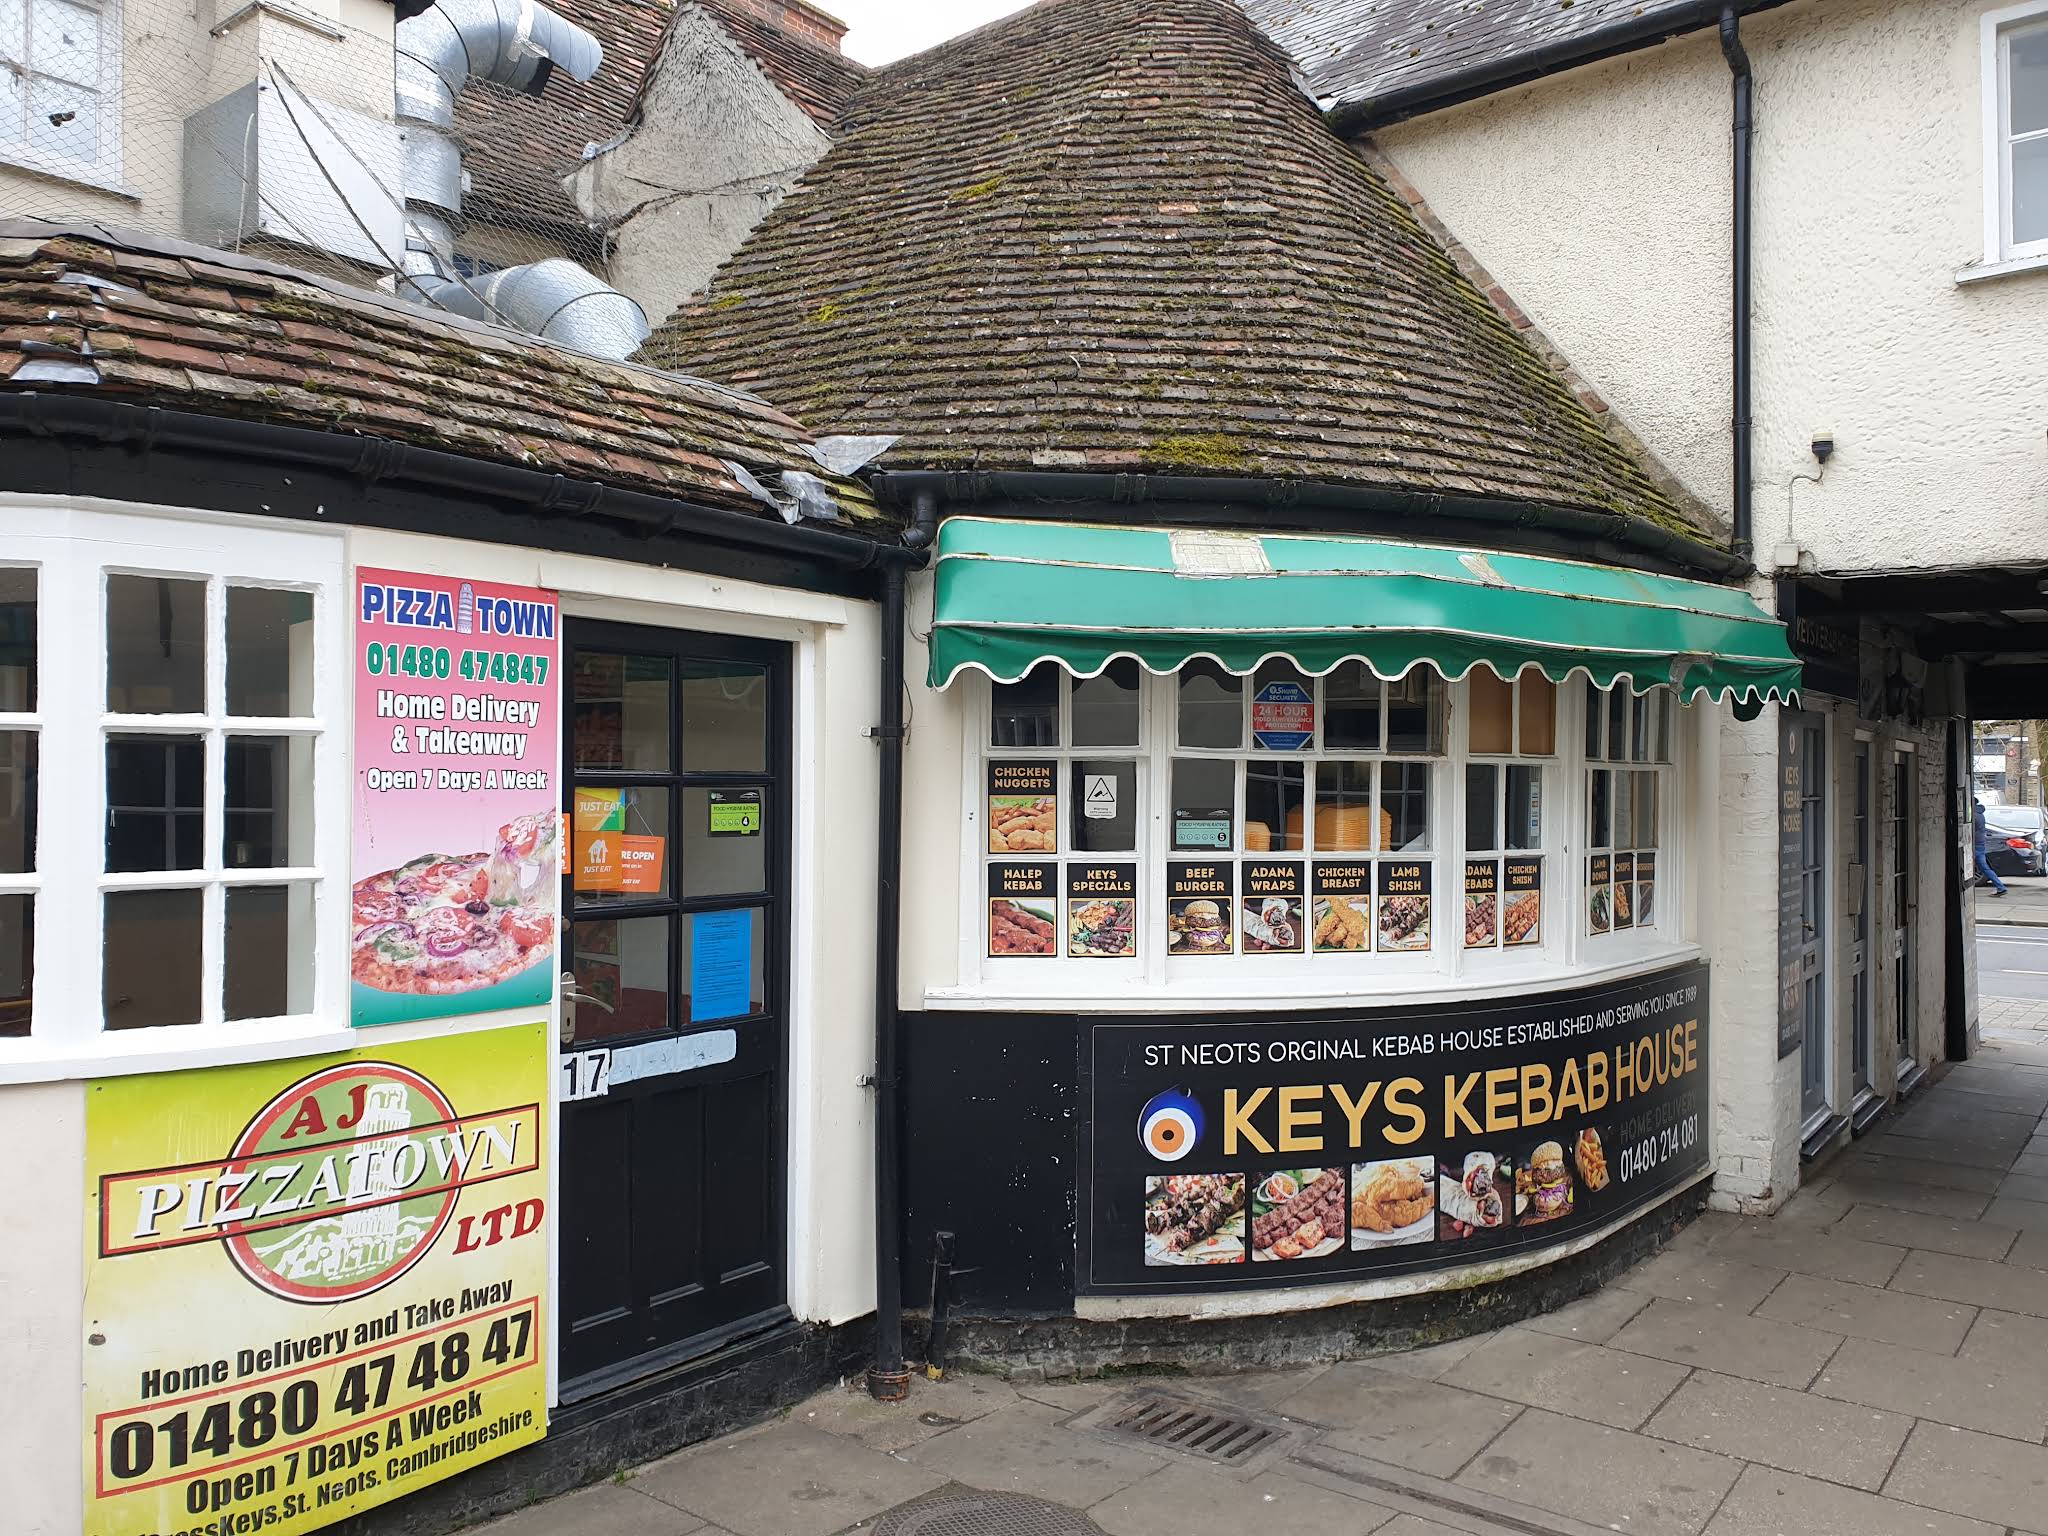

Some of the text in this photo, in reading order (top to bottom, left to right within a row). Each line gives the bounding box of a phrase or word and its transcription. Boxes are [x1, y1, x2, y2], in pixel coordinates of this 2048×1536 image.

[362, 583, 555, 640] PIZZA TOWN
[367, 641, 549, 687] 01480 474847
[377, 689, 540, 728] Home Delivery
[1258, 705, 1308, 717] 24 HOUR
[391, 724, 528, 760] & Takeaway
[994, 767, 1050, 777] CHICKEN
[366, 767, 549, 793] Open 7 Days A Week
[994, 778, 1051, 788] NUGGETS
[579, 801, 622, 812] JUST EAT
[742, 817, 749, 826] 4
[1219, 833, 1225, 841] 5
[632, 851, 655, 861] OPEN
[583, 865, 613, 874] JUST EAT
[1251, 867, 1295, 878] ADANA
[1317, 867, 1365, 877] CHICKEN
[1391, 867, 1420, 877] LAMB
[1507, 865, 1538, 875] CHICKEN
[1615, 862, 1631, 872] CHIPS
[1003, 869, 1043, 879] HALEP
[1087, 869, 1117, 880] KEYS
[1186, 868, 1215, 879] BEEF
[1003, 880, 1043, 891] KEBAB
[1251, 880, 1296, 891] WRAPS
[1322, 878, 1361, 889] BREAST
[1388, 880, 1422, 891] SHISH
[1465, 878, 1494, 889] EBABS
[1512, 875, 1533, 885] SHISH
[1072, 881, 1132, 892] SPECIALS
[1175, 881, 1225, 892] BURGER
[1144, 1044, 1174, 1067] ST
[1181, 1042, 1261, 1066] NEOTS
[1267, 1038, 1366, 1063] ORGINAL
[1372, 1033, 1435, 1057] KEBAB
[1440, 1027, 1503, 1052] HOUSE
[1507, 1014, 1593, 1046] ESTABLISHED
[1595, 1009, 1615, 1031] AND
[1616, 1000, 1650, 1025] SERVING
[1649, 995, 1665, 1014] YOU
[1665, 988, 1685, 1009] SINCE
[563, 1053, 606, 1096] 17
[1223, 1018, 1698, 1155] KEYS KEBAB HOUSE
[1620, 1089, 1697, 1144] HOME DELIVERY
[1620, 1112, 1698, 1183] 01480 214 081
[131, 1120, 521, 1240] PIZZATOWN
[452, 1197, 545, 1255] LTD
[141, 1279, 513, 1399] Home Delivery and Take Away
[110, 1310, 533, 1479] 01480 47 48 47
[186, 1389, 482, 1514] Open 7 Days A Week
[317, 1470, 381, 1508] Neots.
[386, 1408, 533, 1481] Cambridgeshire
